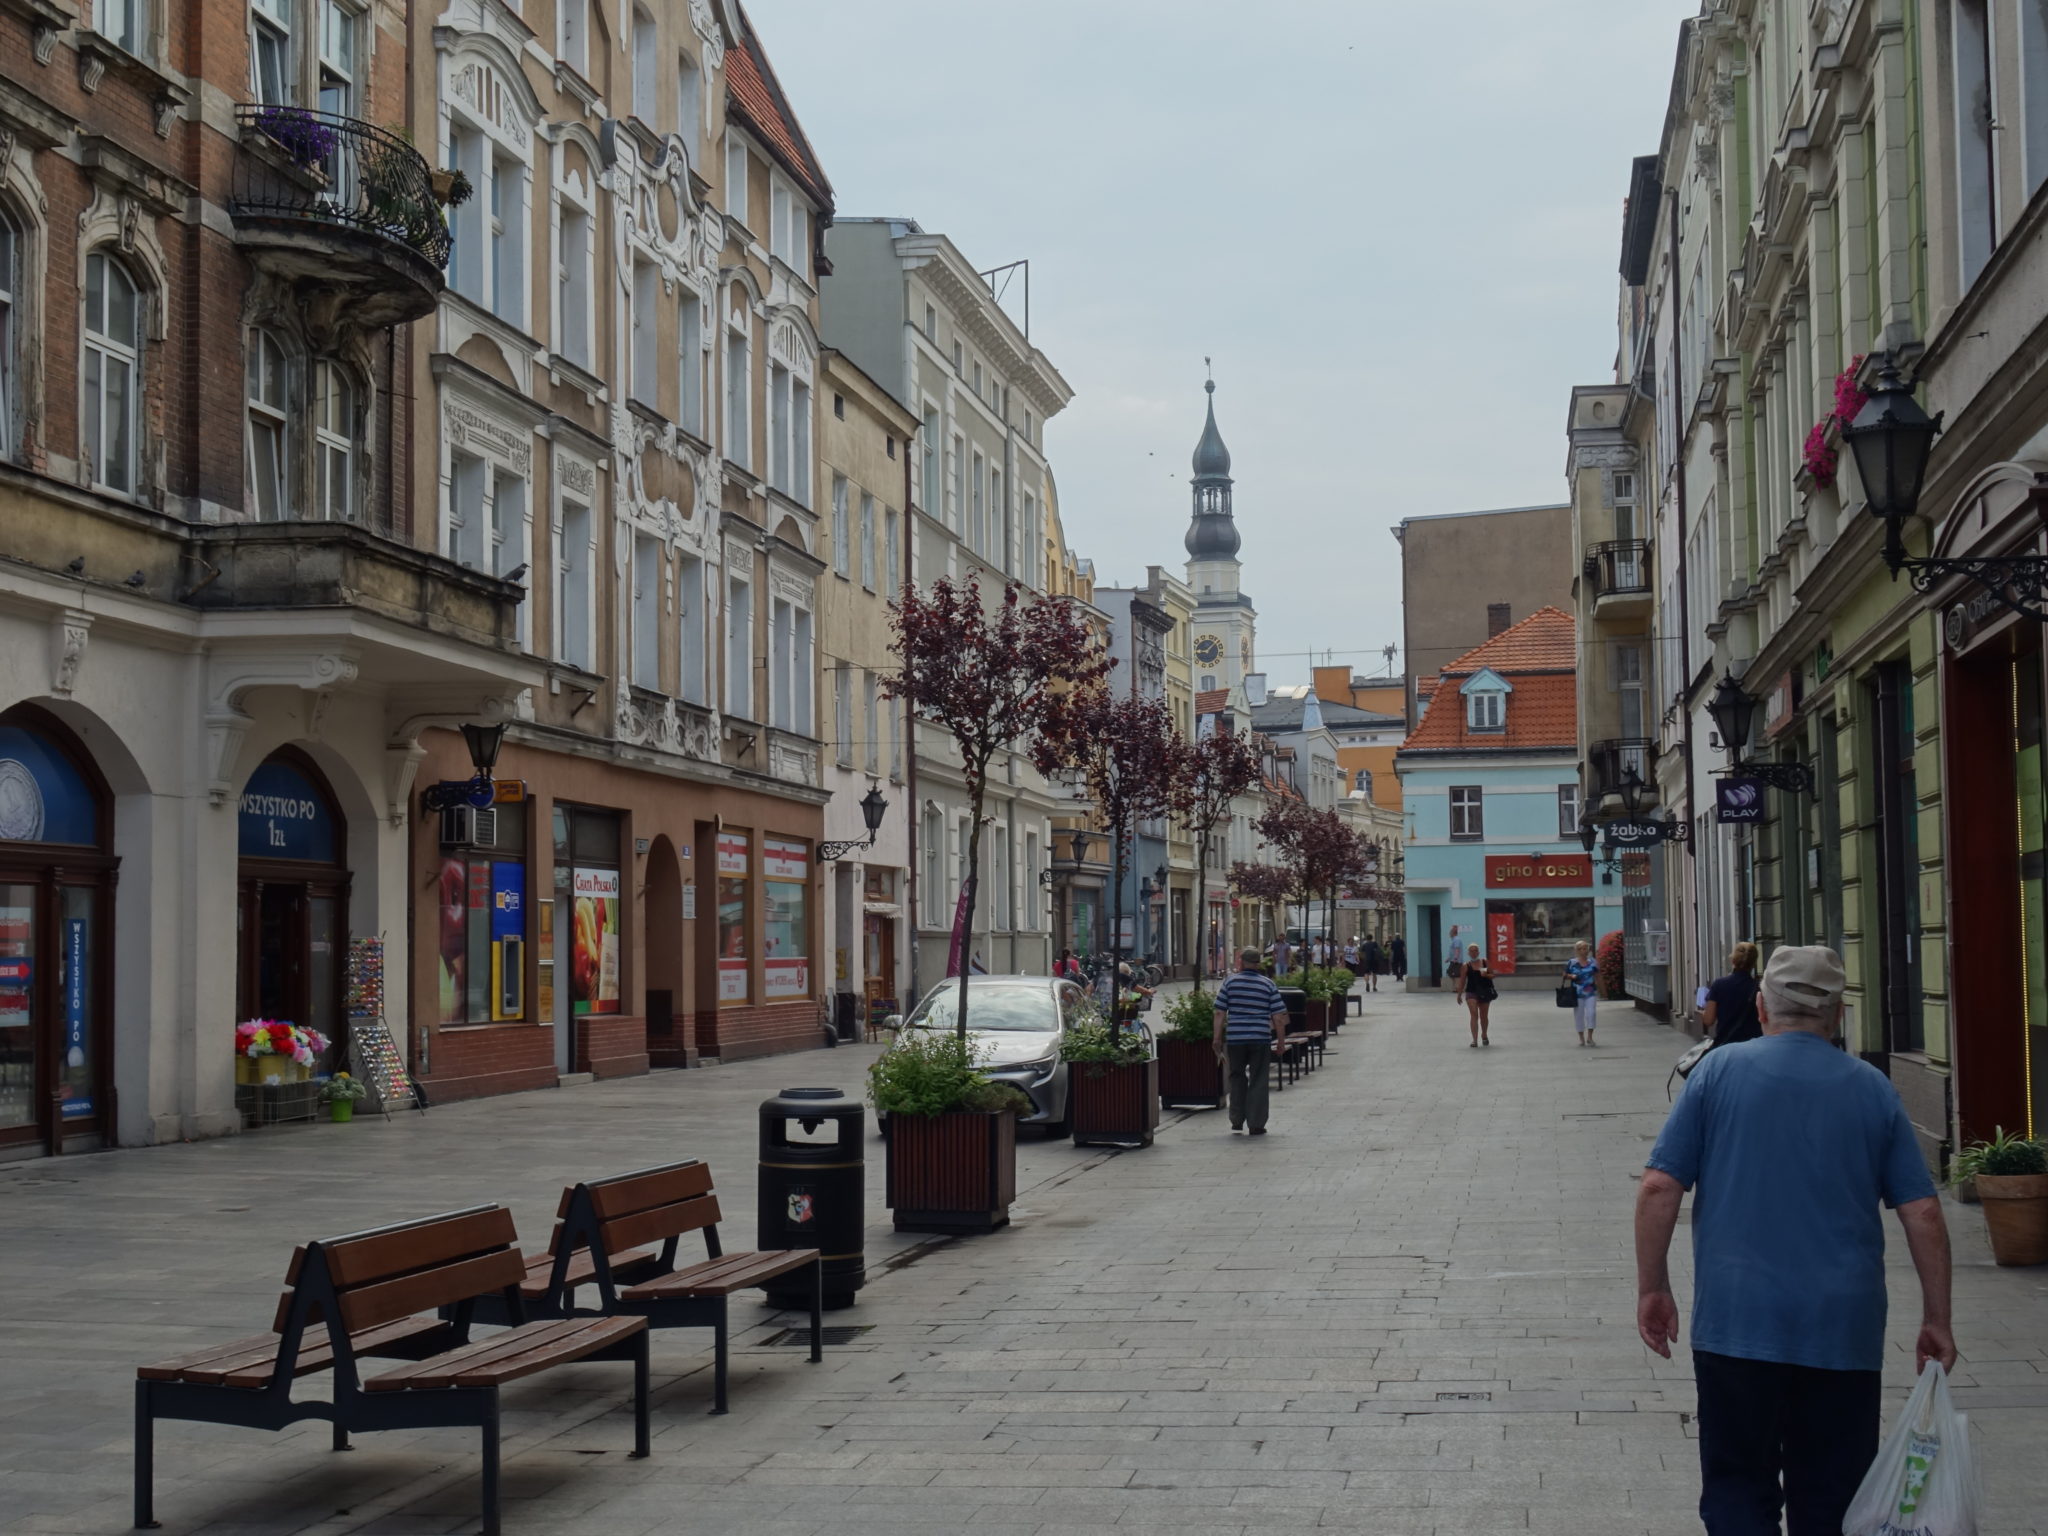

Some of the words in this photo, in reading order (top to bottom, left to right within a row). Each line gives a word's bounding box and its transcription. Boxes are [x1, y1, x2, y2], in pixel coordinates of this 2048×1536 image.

[239, 793, 297, 818] WSZYSTKO
[299, 800, 315, 820] PO
[1722, 808, 1758, 818] PLAY
[1495, 863, 1532, 882] gino
[1538, 863, 1583, 877] rossi
[1496, 925, 1508, 962] SALE
[73, 922, 81, 1009] WSZYSTKO
[73, 1020, 80, 1042] PO
